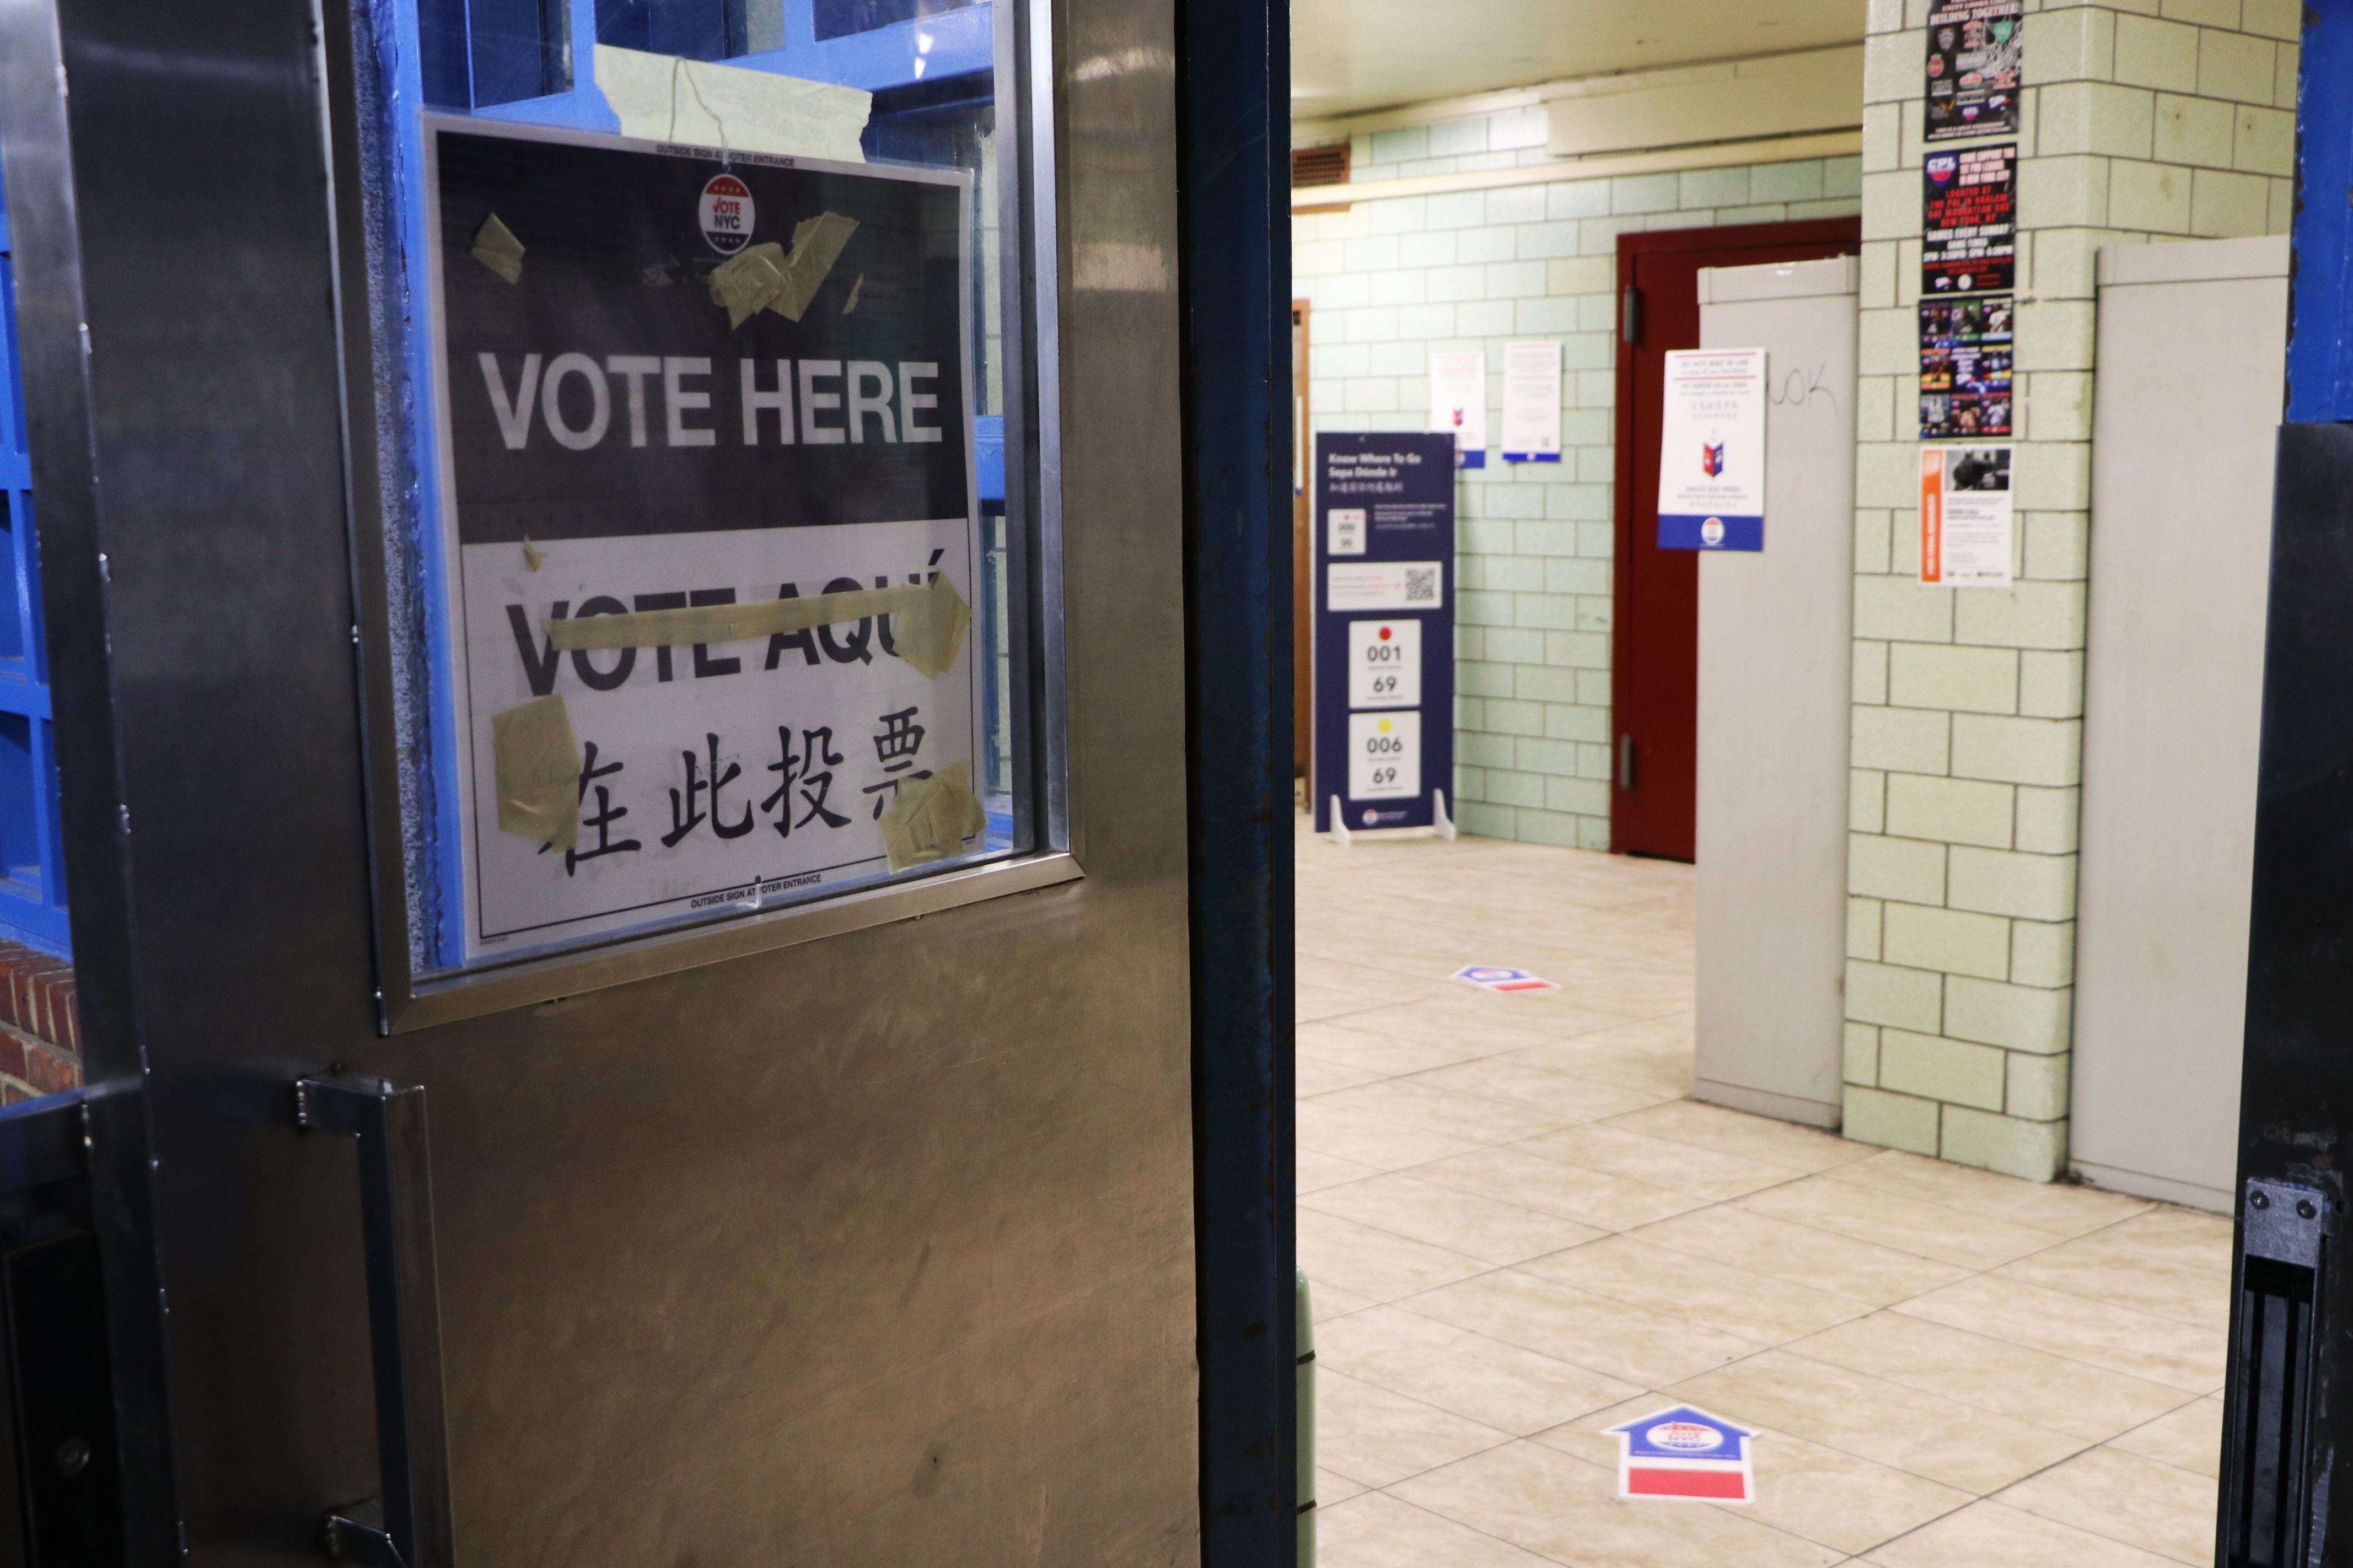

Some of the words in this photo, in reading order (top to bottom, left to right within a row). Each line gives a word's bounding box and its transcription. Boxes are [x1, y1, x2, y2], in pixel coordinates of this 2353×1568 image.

[657, 144, 692, 157] OUTSIDE
[694, 148, 713, 158] SIGN
[728, 152, 753, 162] OTER
[754, 153, 795, 168] ENTRANCE
[1946, 187, 1979, 198] LOCATED
[713, 197, 740, 215] VOTE
[714, 214, 740, 230] NYC
[478, 353, 716, 450] VOTE
[740, 358, 942, 446] HERE
[1328, 452, 1358, 464] Know
[1358, 452, 1392, 464] Where
[1393, 452, 1405, 464] To
[1406, 452, 1422, 465] Go
[506, 587, 741, 697] VOTE
[1367, 645, 1401, 661] 001
[1373, 676, 1397, 692] 69
[1367, 737, 1403, 753] 006
[1373, 767, 1397, 784] 69
[538, 705, 933, 877] 在此投票
[691, 893, 725, 908] OUTSIDE
[726, 890, 745, 901] SIGN
[746, 887, 756, 897] AT
[760, 882, 782, 893] OTER
[783, 874, 821, 890] ENTRANCE
